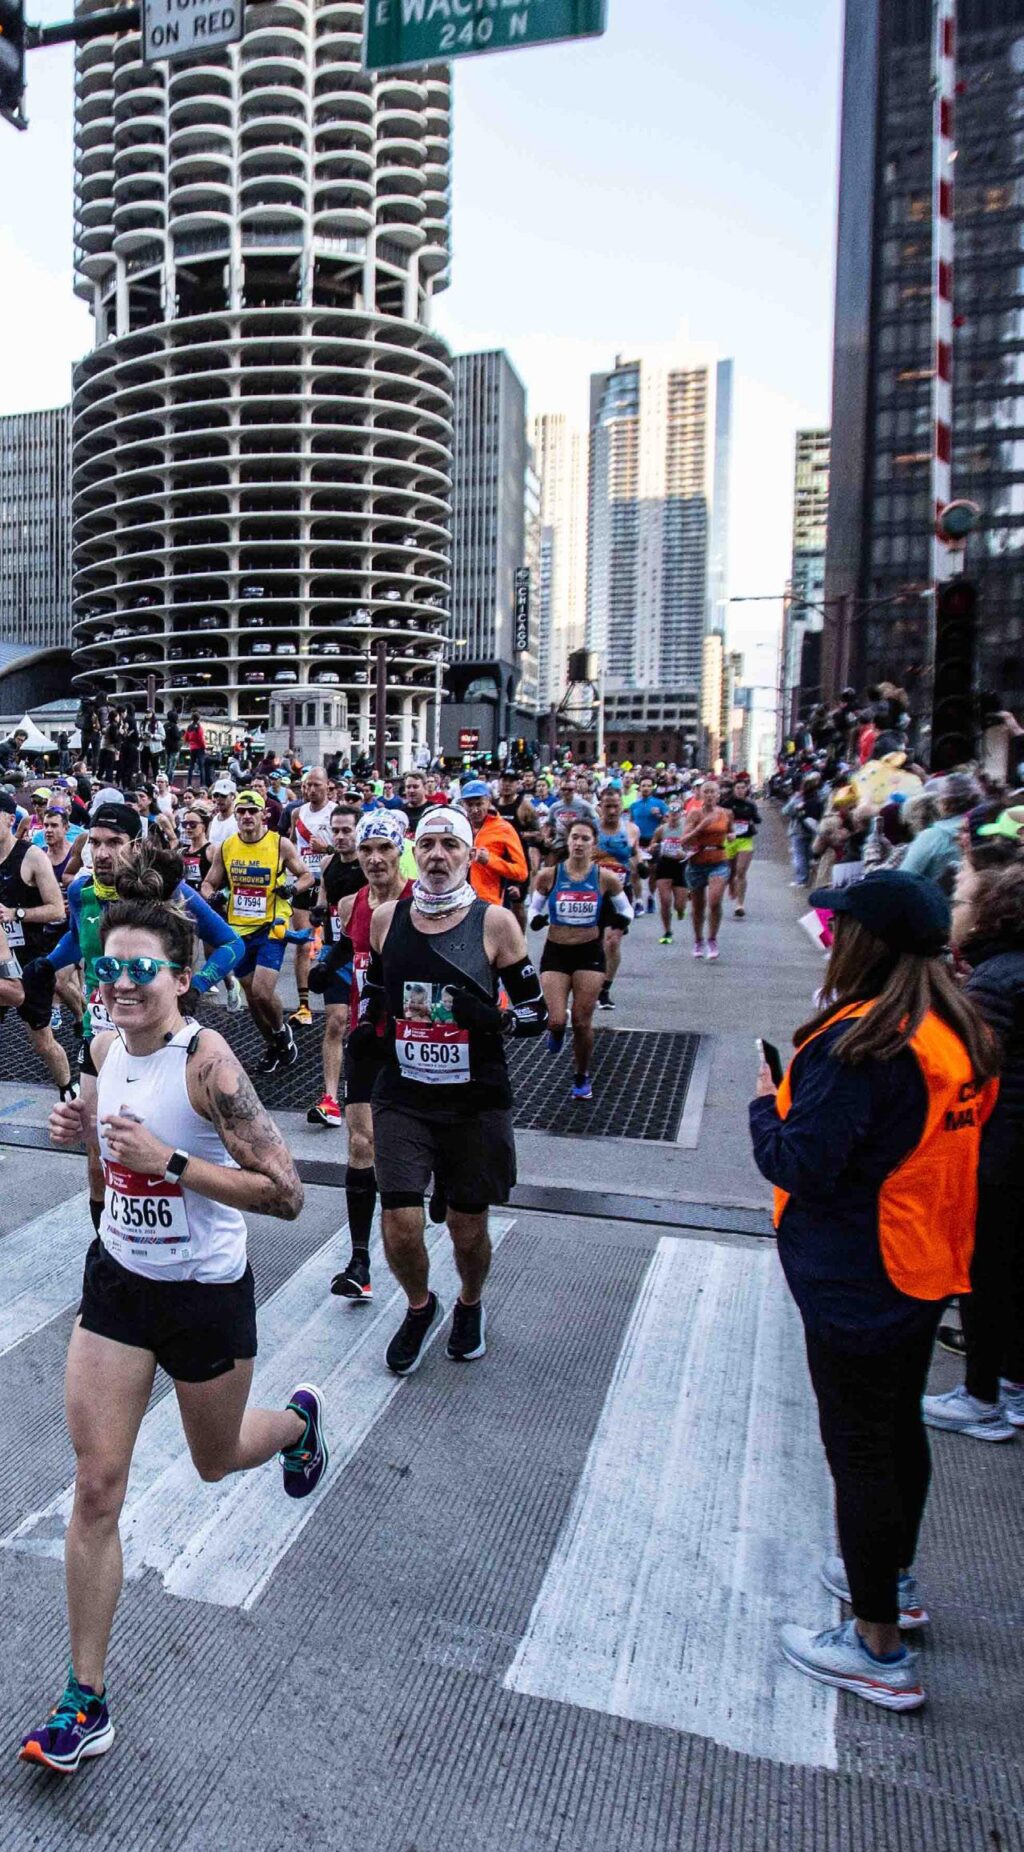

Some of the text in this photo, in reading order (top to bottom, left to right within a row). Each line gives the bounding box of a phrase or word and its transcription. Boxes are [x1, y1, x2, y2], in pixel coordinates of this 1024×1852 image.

[151, 8, 235, 47] ON RED
[376, 1, 389, 25] E
[439, 11, 529, 49] 240 N
[517, 587, 527, 648] CHICAGO
[245, 896, 261, 908] 7594
[568, 902, 594, 913] 16180
[404, 1042, 460, 1064] C 6503
[111, 1191, 173, 1228] C 3566
